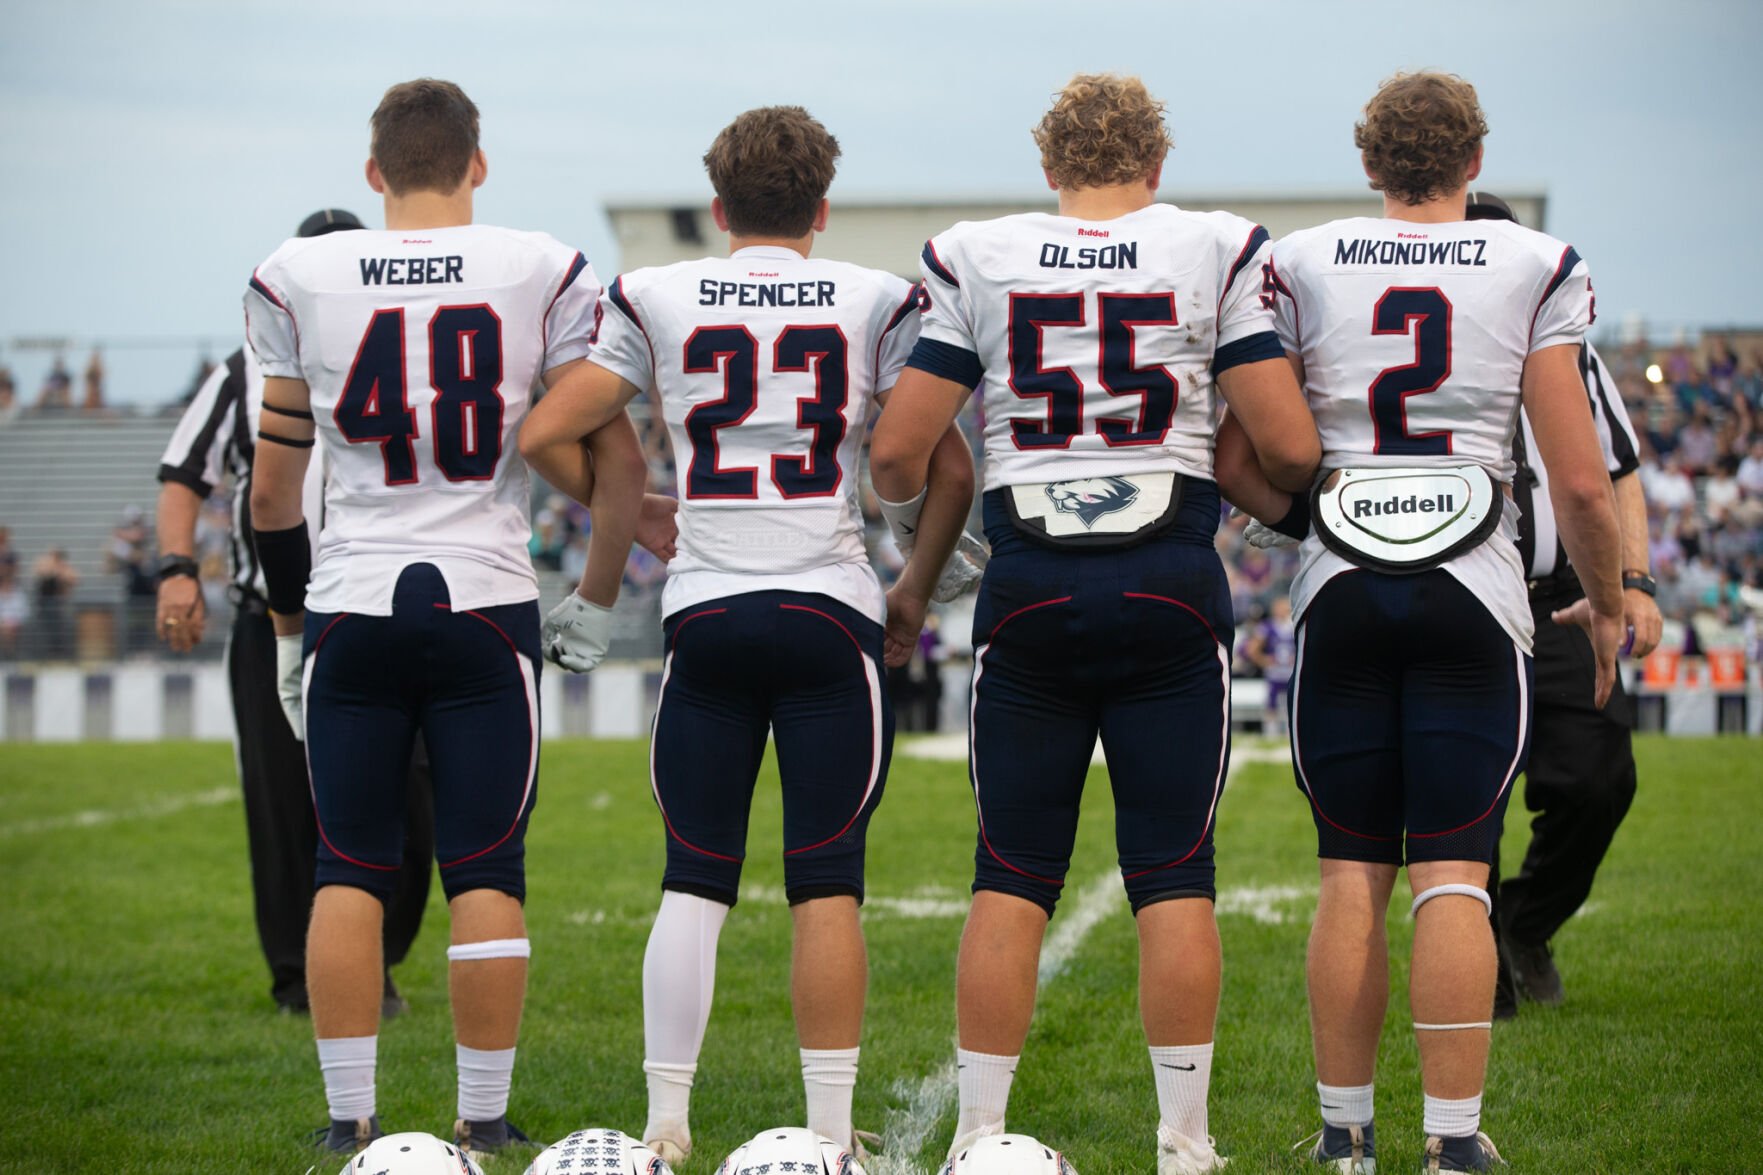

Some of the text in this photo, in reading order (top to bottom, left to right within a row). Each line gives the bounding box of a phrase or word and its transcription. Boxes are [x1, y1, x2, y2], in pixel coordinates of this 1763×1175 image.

[1078, 228, 1109, 238] Riddell
[1039, 241, 1138, 269] OLSON
[1334, 239, 1487, 266] MIKONOWICZ
[359, 255, 464, 286] WEBER
[699, 279, 836, 307] SPENCER
[1007, 291, 1179, 450] 55
[1368, 286, 1453, 456] 2
[333, 302, 504, 486] 48
[683, 323, 849, 500] 23
[1353, 494, 1454, 518] Riddell
